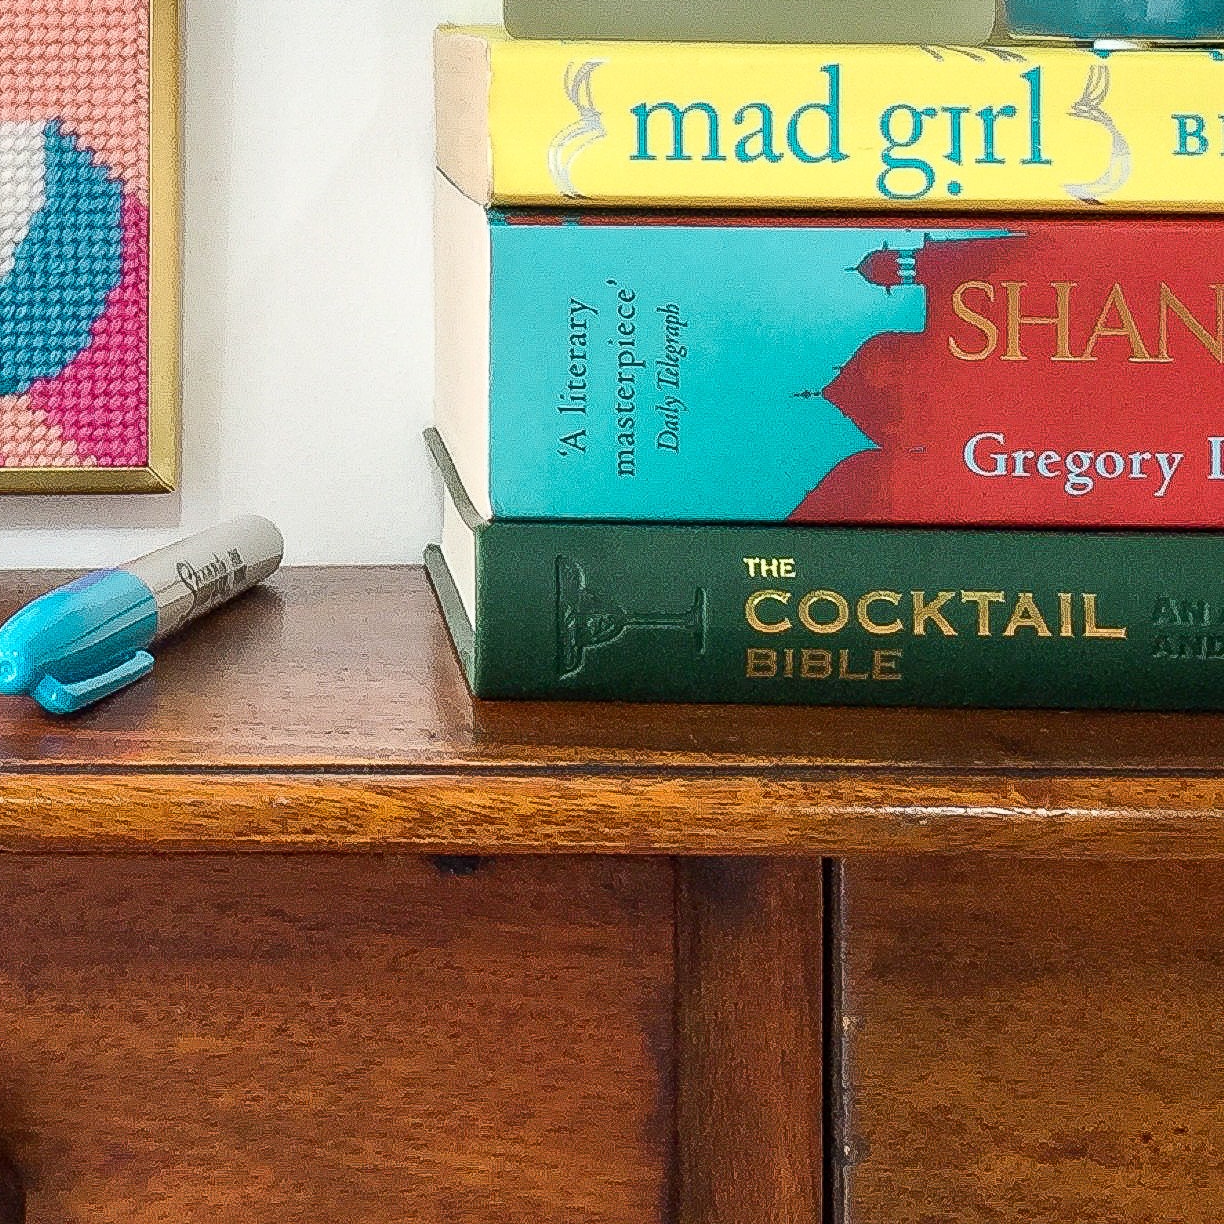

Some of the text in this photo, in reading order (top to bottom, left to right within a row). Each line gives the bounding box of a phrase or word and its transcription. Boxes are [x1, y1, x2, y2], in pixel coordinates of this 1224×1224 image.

[630, 63, 1052, 200] mad girl
[1171, 113, 1224, 156] B
[557, 297, 599, 415] literary
[948, 280, 1224, 363] SHAN
[606, 278, 647, 477] masterpiece'
[655, 302, 688, 454] Daily Telegraph
[963, 432, 1184, 497] Gregory
[743, 557, 796, 579] THE
[744, 589, 1127, 639] COCKTAIL
[745, 648, 903, 680] BIBLE
